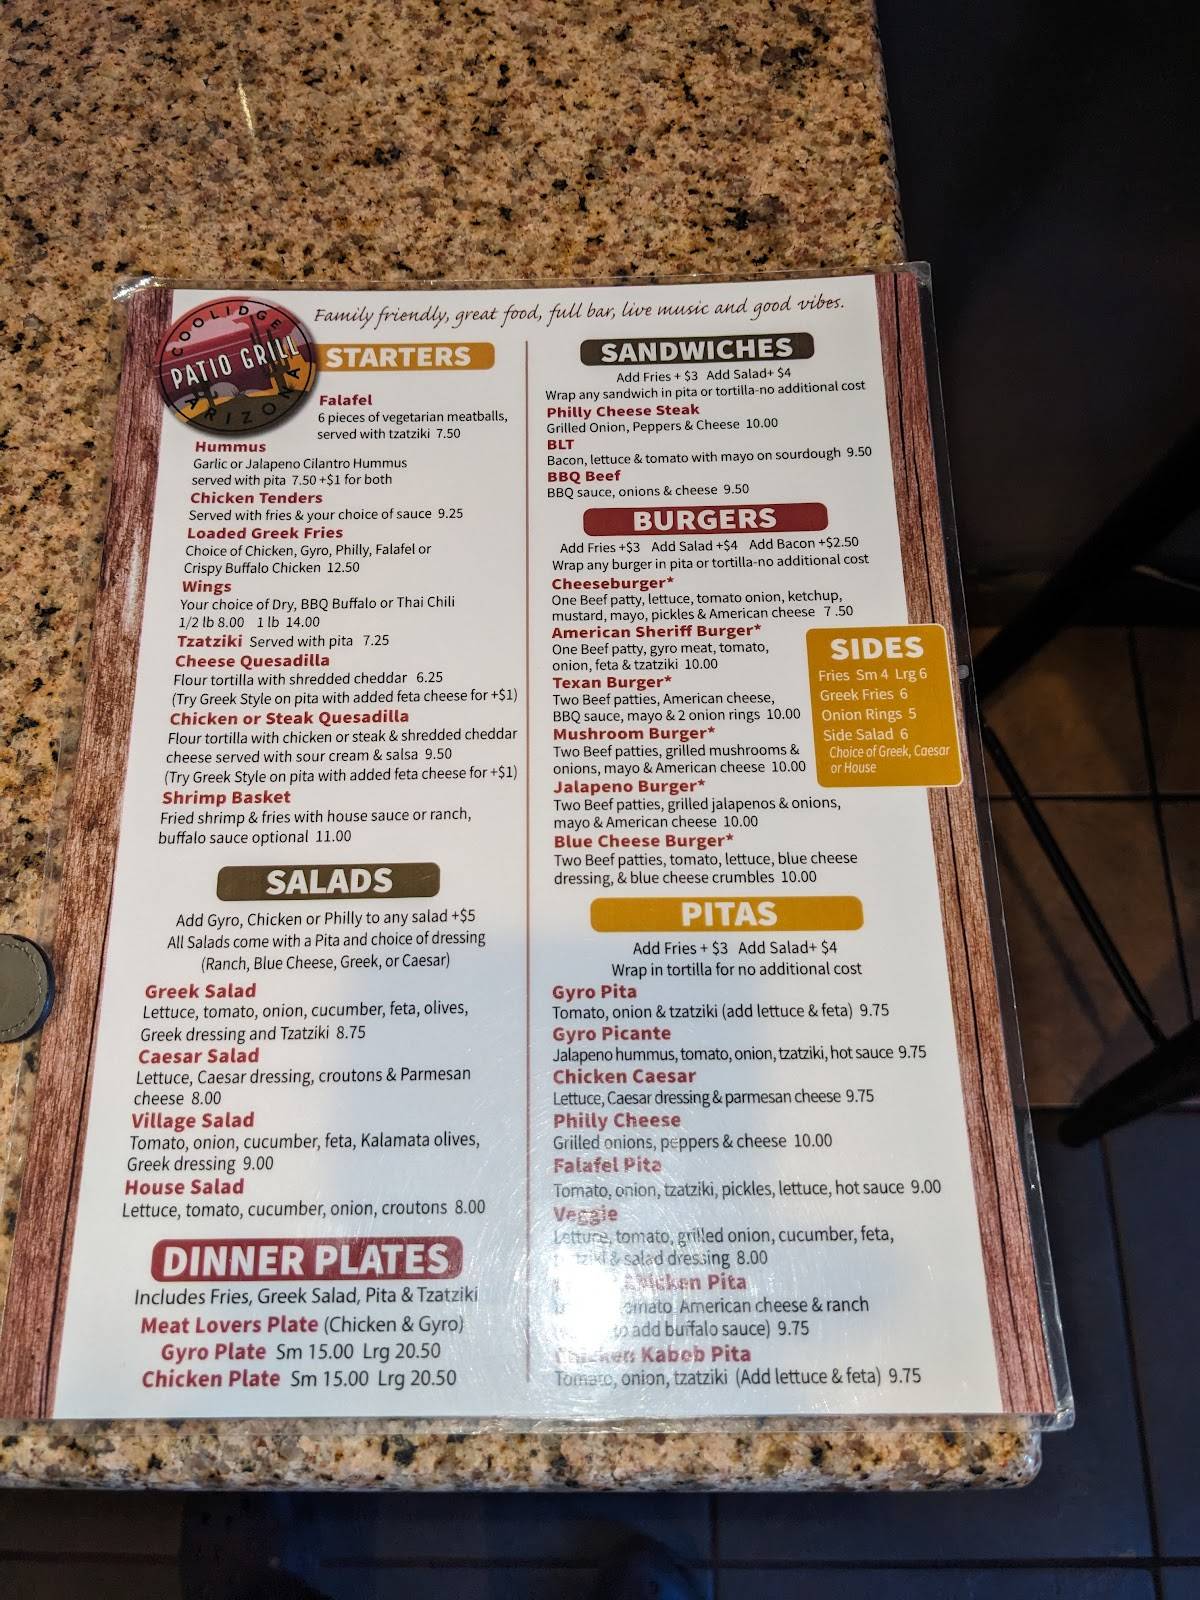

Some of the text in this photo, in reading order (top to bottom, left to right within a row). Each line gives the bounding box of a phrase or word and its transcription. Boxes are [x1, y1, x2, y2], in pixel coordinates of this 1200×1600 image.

[313, 293, 845, 330] Family friendly, great food, full bar, live music and good vibes.
[172, 305, 282, 357] COOLIDGE
[326, 346, 472, 368] STARTERS
[601, 338, 794, 362] SANDWICHES
[170, 335, 300, 390] PATIO GRILL
[184, 367, 301, 425] ARIZONA
[319, 393, 372, 406] Falafel
[318, 410, 507, 425] 6 pieces of vegetarian meatballs,
[547, 403, 700, 420] Philly Cheese Steak
[317, 427, 460, 440] served with tzatziki 7.50
[195, 440, 266, 453] Hummus
[547, 439, 574, 450] BLT
[547, 469, 621, 485] BBQ Beef
[190, 491, 323, 504] Chicken Tenders
[633, 508, 776, 530] BURGERS
[187, 525, 343, 539] Loaded Greek Fries
[183, 561, 359, 577] Crispy Buffalo Chicken 12.50
[182, 579, 231, 596] Wings
[178, 615, 320, 630] 1/2 lb 8.00 1 lb 14.00
[551, 625, 630, 638] American
[635, 624, 692, 637] Sheriff
[177, 633, 389, 650] Tzatziki Served with pita 7.25
[830, 636, 924, 660] SIDES
[175, 653, 329, 670] Cheese Quesadilla
[552, 658, 718, 673] onion, feta & tzatziki 10.00
[552, 676, 601, 688] Texan
[818, 667, 927, 683] Fries Sm 4 Lrg 6
[819, 687, 908, 701] Greek Fries 6
[821, 707, 917, 723] Onion Rings 5
[823, 727, 908, 741] Side Salad 6
[829, 744, 950, 759] Choice of Greek, Caesar
[830, 760, 877, 774] or House
[553, 779, 633, 796] Jalapeno
[162, 789, 291, 807] Shrimp Basket
[554, 814, 758, 832] mayo & American cheese 10.00
[158, 829, 351, 846] buffalo sauce optional 11.00
[554, 834, 592, 848] Blue
[597, 833, 660, 847] Cheese
[265, 867, 392, 895] SALADS
[681, 901, 777, 927] PITAS
[145, 982, 256, 999] Greek Salad
[552, 984, 637, 1002] Gyro Pita
[140, 1025, 365, 1044] Greek dressing and Tzatziki 8.75
[552, 1026, 671, 1044] Gyro Picante
[138, 1047, 259, 1064] Caesar Salad
[553, 1068, 696, 1084] Chicken Caesar
[132, 1111, 254, 1131] Village Salad
[553, 1111, 681, 1130] Philly Cheese
[553, 1132, 832, 1152] Grilled onions, peppers & cheese 10.00
[124, 1177, 244, 1195] House Salad
[163, 1242, 451, 1277] DINNER PLATES
[134, 1286, 477, 1306] Includes Fries, Greek Salad, Pita & Tzatziki
[161, 1342, 440, 1363] Gyro Plate Sm 15.00 Lrg 20.50
